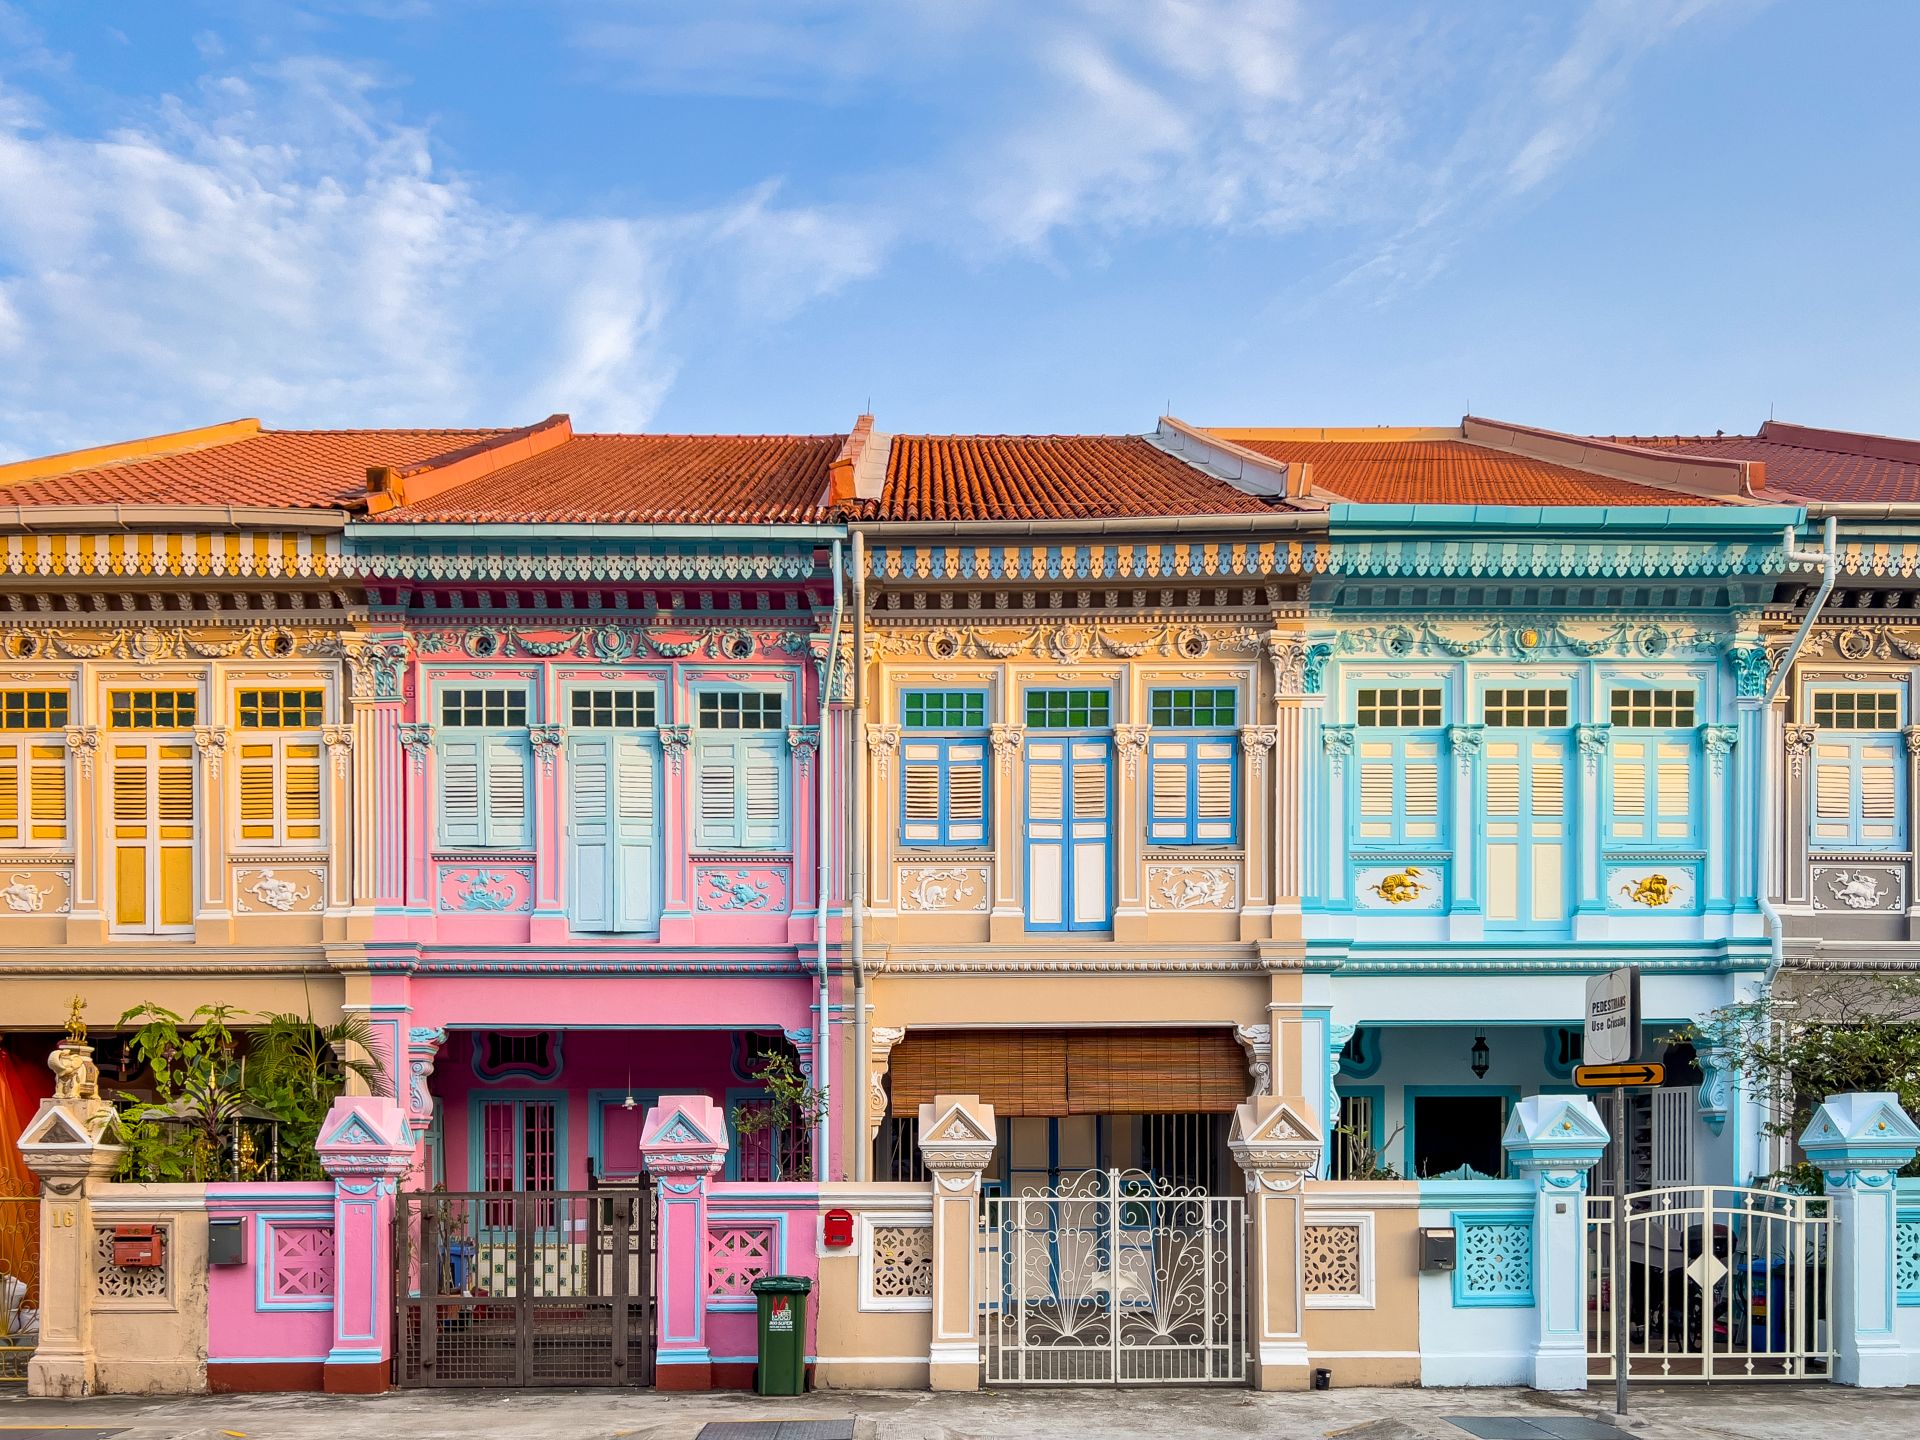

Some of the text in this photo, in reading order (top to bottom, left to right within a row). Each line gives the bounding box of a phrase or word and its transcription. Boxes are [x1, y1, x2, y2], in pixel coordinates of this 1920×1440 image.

[1592, 995, 1626, 1013] PEDESTRIANS
[1592, 1021, 1604, 1031] Use
[52, 1208, 74, 1228] 16
[353, 1207, 366, 1215] 14
